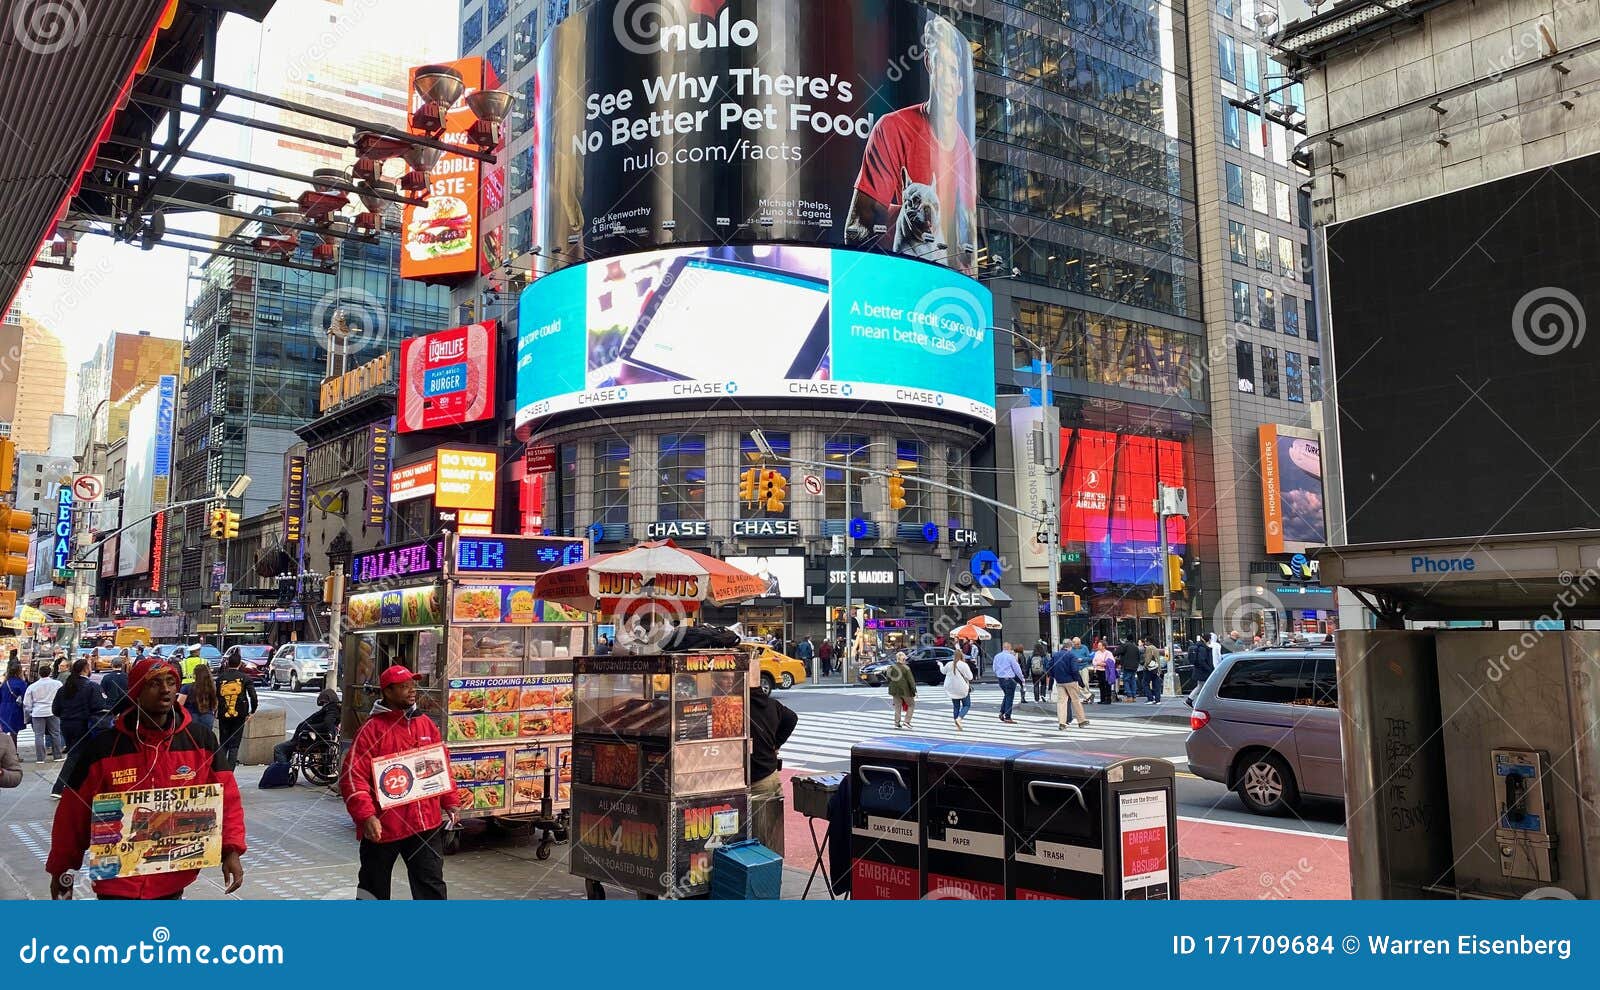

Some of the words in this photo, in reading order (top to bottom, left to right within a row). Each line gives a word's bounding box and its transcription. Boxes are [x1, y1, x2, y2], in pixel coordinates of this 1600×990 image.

[660, 6, 758, 52] nulo
[585, 88, 632, 121] See
[642, 71, 719, 104] Why
[729, 67, 852, 103] There's
[571, 129, 603, 158] No
[611, 108, 708, 146] Better
[720, 103, 777, 131] Pet
[790, 104, 875, 139] Food
[622, 139, 802, 172] nulo.com/facts
[759, 199, 795, 208] Michael
[798, 199, 832, 211] Phelps,
[760, 207, 784, 216] Juno
[786, 208, 793, 217] &
[796, 208, 831, 219] Legend
[592, 216, 606, 226] Gus
[608, 206, 651, 222] Kenworthy
[850, 300, 861, 315] A
[864, 302, 903, 320] better
[907, 310, 939, 328] credit
[940, 318, 966, 335] score
[540, 319, 561, 337] could
[851, 325, 890, 340] mean
[893, 327, 929, 345] better
[932, 336, 957, 352] rates
[430, 375, 460, 393] BURGER
[673, 383, 722, 395] CHASE
[789, 382, 839, 394] CHASE
[578, 390, 615, 404] CHASE
[896, 389, 934, 404] CHASE
[373, 427, 387, 487] VICTORY
[535, 448, 556, 456] STANDING
[1265, 441, 1274, 476] REUTERS
[441, 454, 460, 466] DO
[462, 456, 487, 468] YOU
[393, 473, 402, 482] DO
[401, 468, 414, 478] YOU
[288, 458, 303, 510] VICTORY
[1266, 477, 1276, 517] THOMSON
[371, 495, 384, 524] NEW
[1076, 500, 1106, 511] AIRLINES
[55, 489, 73, 570] REGAL
[287, 515, 300, 541] NEW
[647, 521, 707, 538] CHASE
[733, 520, 798, 536] CHASE
[361, 544, 430, 580] FALAFEL
[1068, 553, 1074, 561] 42
[1411, 556, 1476, 573] Phone
[598, 571, 644, 595] NUTS
[654, 572, 700, 598] NUTS
[829, 570, 857, 584] STEE
[858, 570, 893, 584] MADDEN
[923, 592, 981, 606] CHASE
[465, 679, 486, 687] FRSH
[487, 677, 521, 686] COOKING
[522, 676, 541, 685] FAST
[542, 675, 572, 684] SERVING
[701, 745, 720, 757] 75
[111, 767, 138, 778] TICKET
[112, 776, 138, 786] AGENT
[384, 775, 407, 790] $29
[125, 791, 152, 804] THE
[153, 786, 187, 801] BEST
[598, 799, 609, 811] ALL
[609, 801, 639, 816] NATURAL
[873, 823, 887, 833] CANS
[891, 826, 914, 837] BOTTLES
[1128, 829, 1161, 846] EMBRACE
[952, 837, 970, 847] PAPER
[1139, 846, 1150, 854] THE
[1043, 850, 1065, 861] TRASH
[636, 864, 654, 879] NUTS
[1131, 857, 1160, 875] ABSURD
[858, 863, 911, 887] EMBRACE
[875, 885, 890, 898] THE
